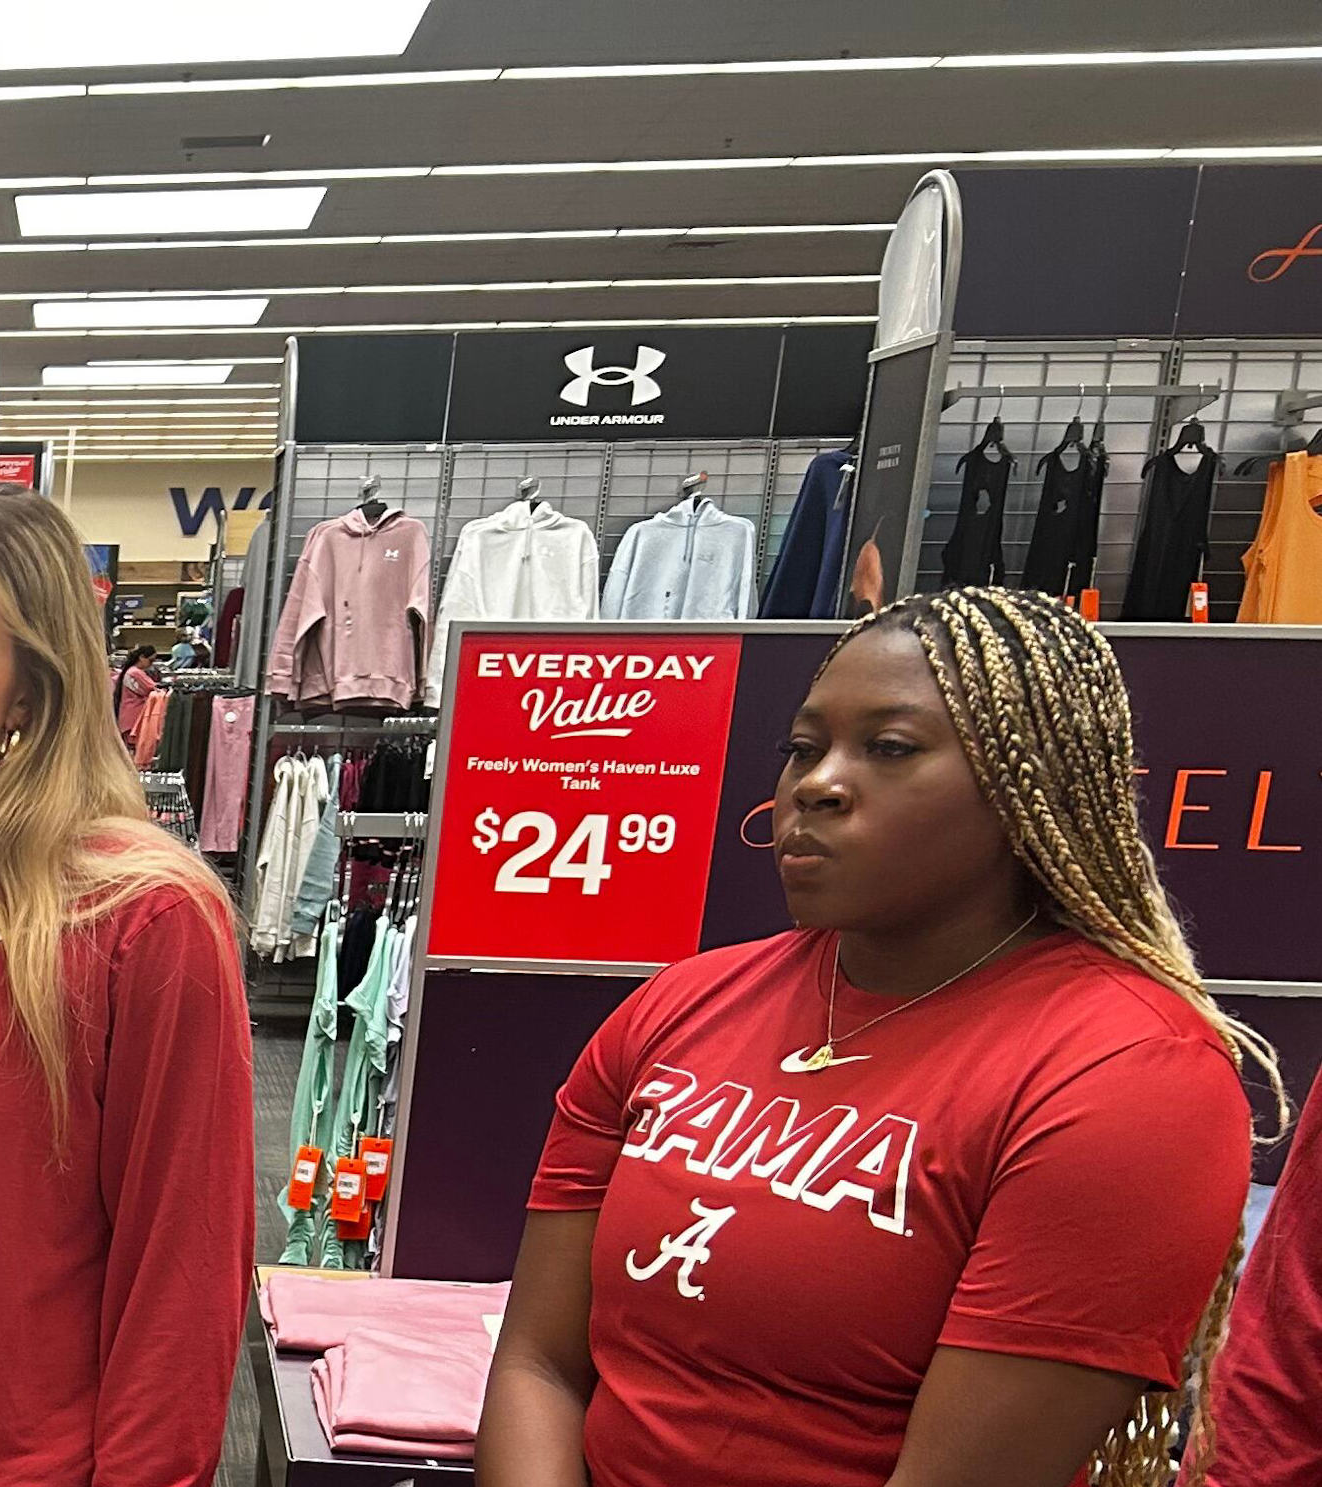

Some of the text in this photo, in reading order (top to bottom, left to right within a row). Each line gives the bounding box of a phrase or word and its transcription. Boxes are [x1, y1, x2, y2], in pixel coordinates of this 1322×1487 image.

[550, 413, 665, 426] UNDER ARMOUR
[476, 652, 715, 681] EVERYDAY
[520, 682, 657, 732] Value
[466, 756, 701, 776] Freely Women's Haven Luxe
[560, 776, 601, 791] Tank
[621, 1062, 920, 1236] BAMA
[625, 1196, 738, 1299] A
